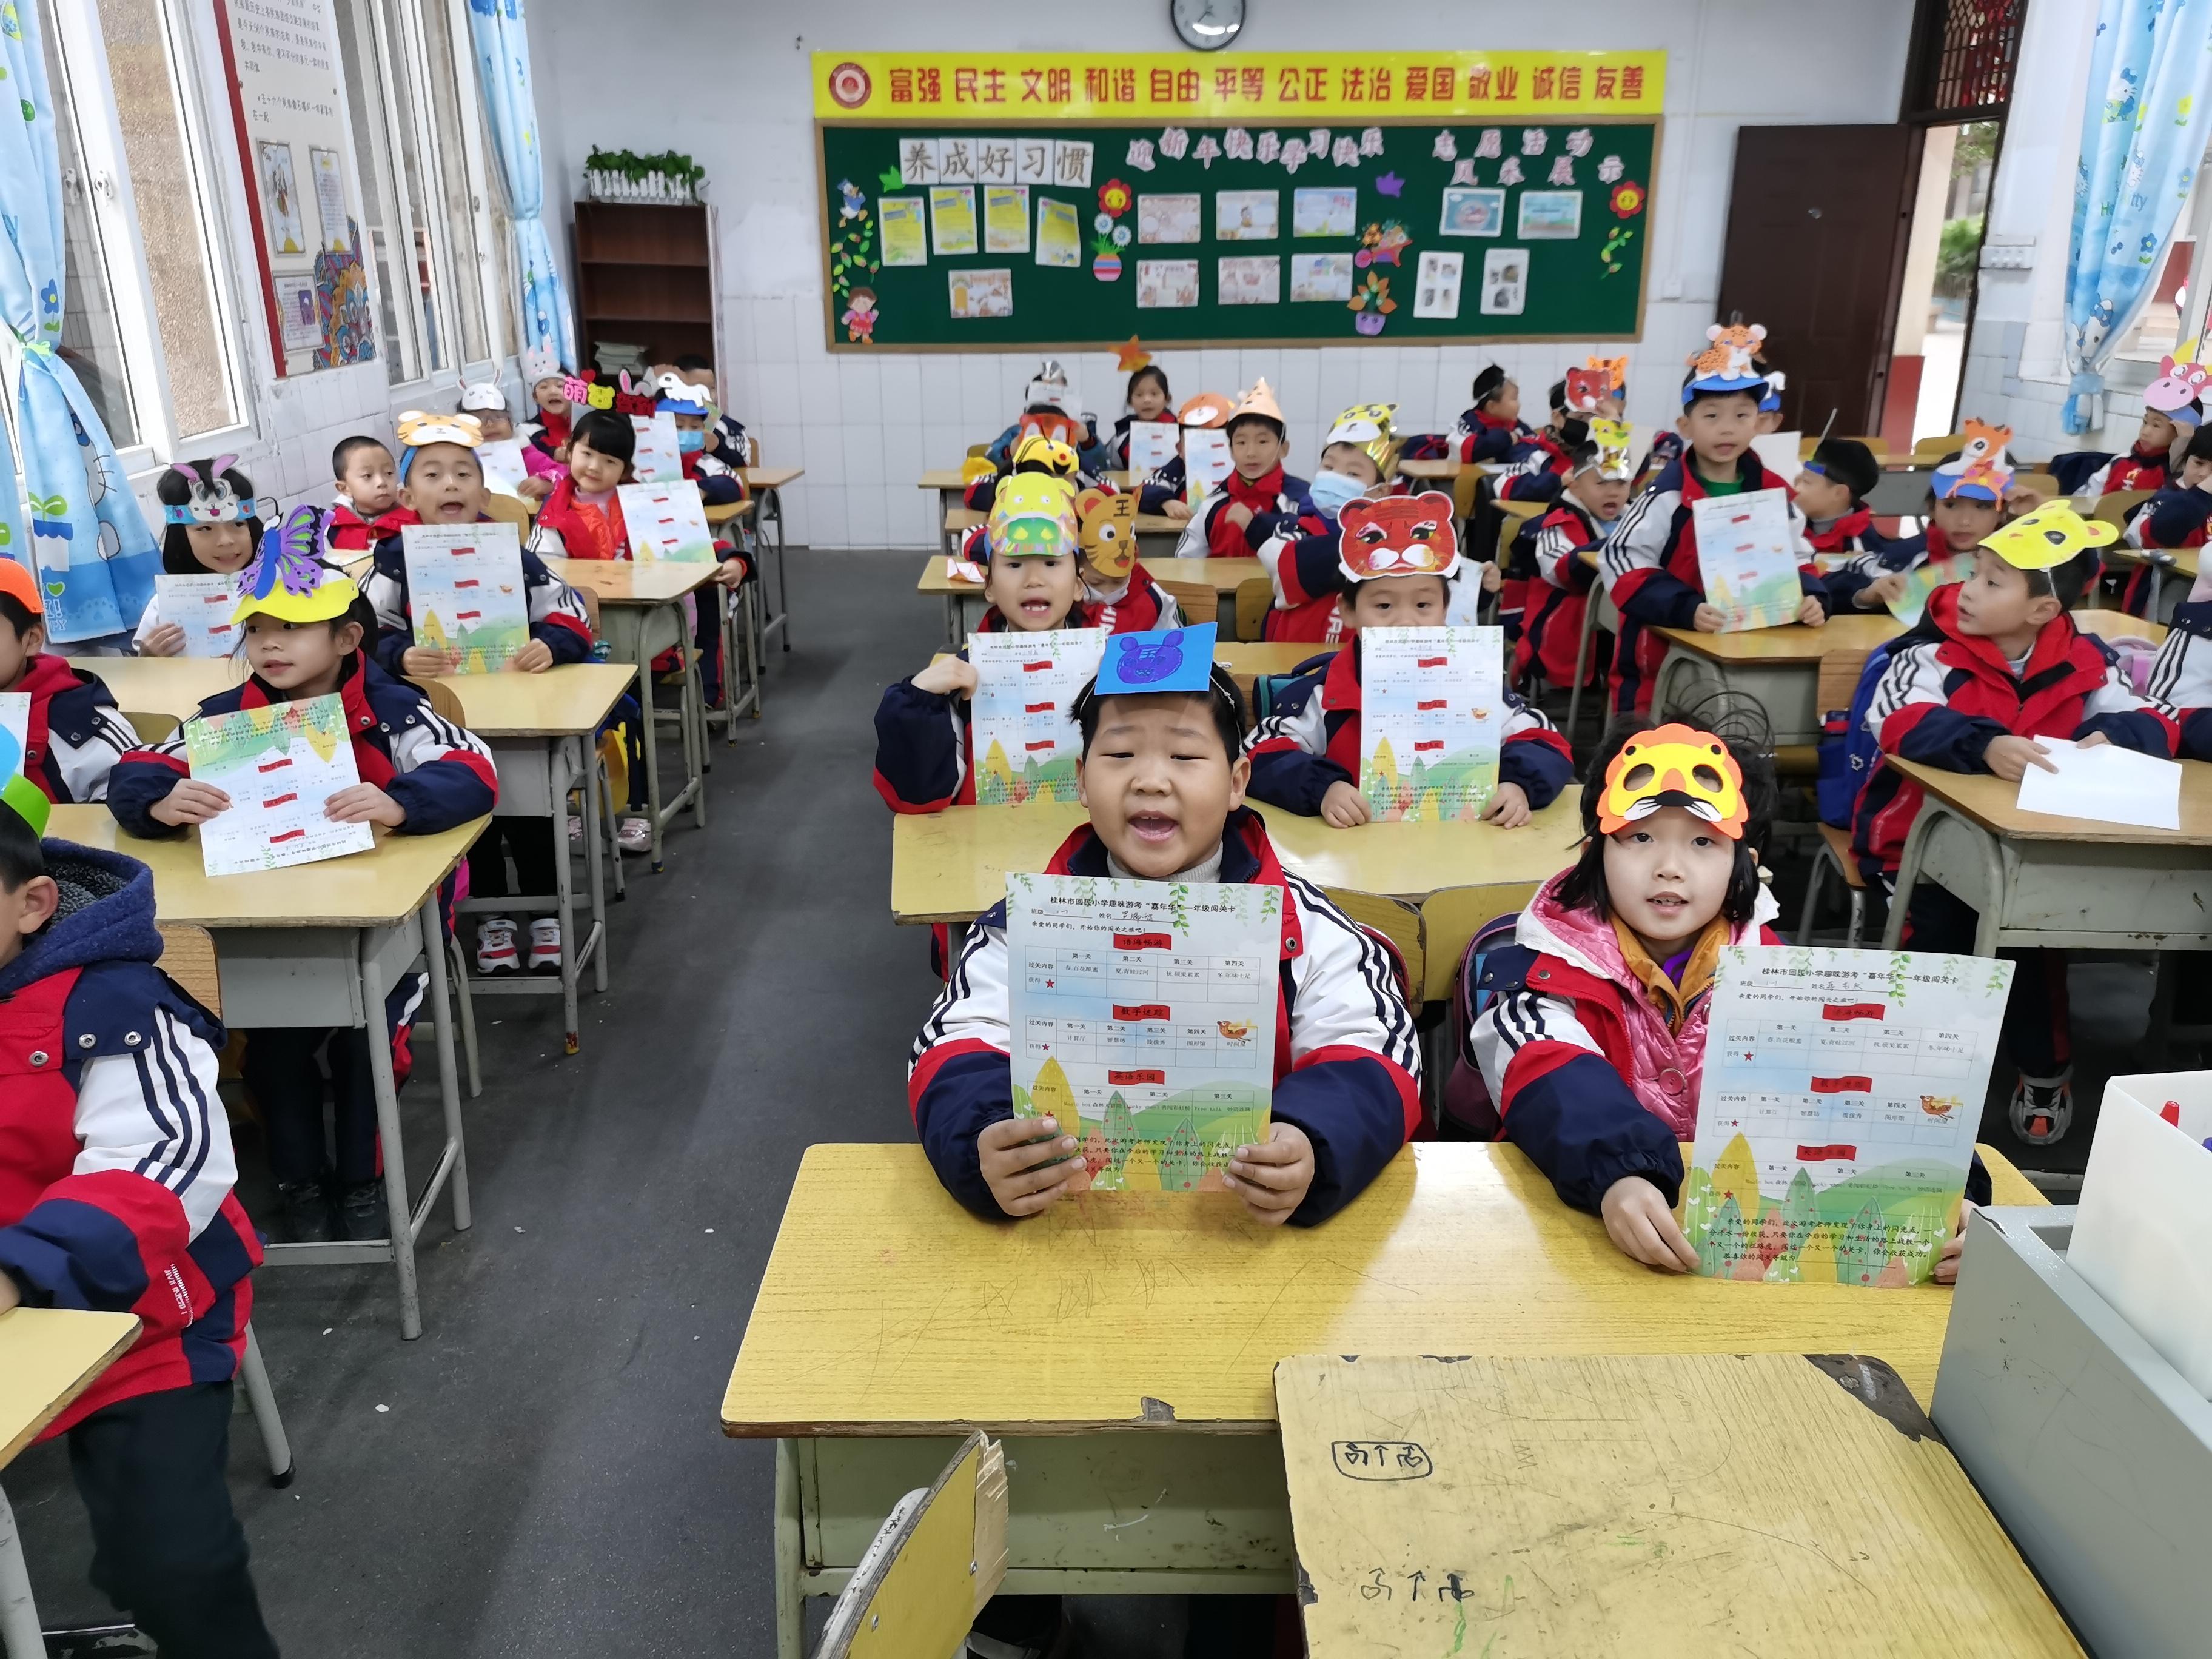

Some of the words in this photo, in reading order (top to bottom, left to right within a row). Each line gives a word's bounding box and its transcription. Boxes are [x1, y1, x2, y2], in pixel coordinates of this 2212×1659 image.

[888, 67, 942, 103] 富强
[954, 67, 1007, 103] 民主
[1021, 67, 1072, 103] 文明
[1084, 67, 1136, 103] 和谐
[1150, 67, 1201, 102] 自由
[1214, 67, 1265, 102] 平等
[1278, 66, 1328, 102] 公正
[1341, 66, 1391, 102] 法治
[1405, 66, 1455, 101] 爱国
[1468, 65, 1519, 101] 敬业
[1532, 65, 1581, 101] 诚信
[1594, 65, 1644, 100] 友善
[904, 141, 1091, 184] 养成好习惯
[1028, 1019, 1054, 1027] 过关内容
[1114, 1072, 1155, 1081] 英语乐园
